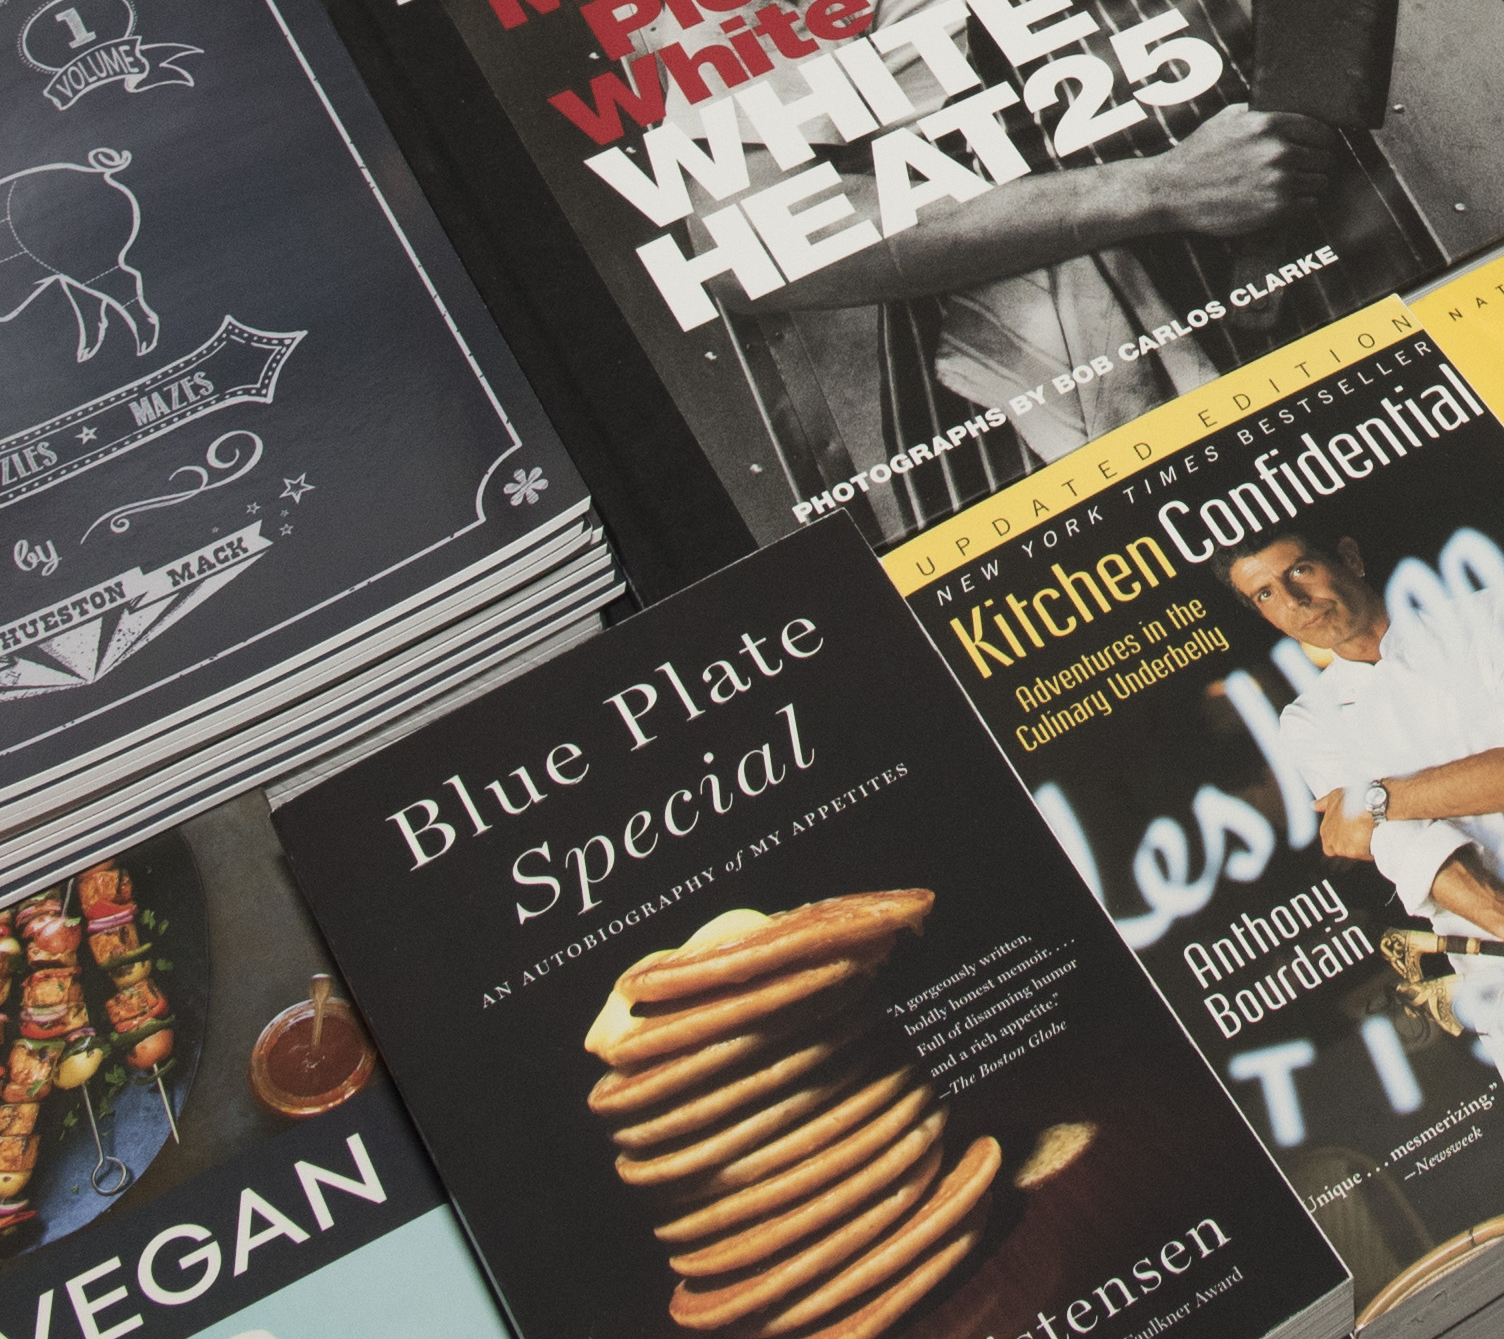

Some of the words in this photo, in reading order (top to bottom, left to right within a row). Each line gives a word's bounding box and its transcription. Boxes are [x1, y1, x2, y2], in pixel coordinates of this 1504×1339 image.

[54, 43, 141, 101] VOLUME
[57, 10, 97, 46] 1
[129, 371, 215, 426] MAZES
[791, 406, 1008, 523] PHOTOGRAPHS
[1009, 384, 1047, 418] BY
[1051, 353, 1114, 399] BOB
[1118, 300, 1225, 366] CARLOS
[1228, 244, 1340, 306] CLARKE
[916, 440, 1155, 577] UPDATED
[1197, 314, 1415, 429] EDITION
[937, 562, 1000, 606] NEW
[1021, 506, 1102, 558] YORK
[1123, 446, 1221, 502] TIMES
[1237, 339, 1432, 444] BESTSELLER
[13, 538, 62, 576] by
[166, 537, 249, 588] MACK
[949, 536, 1178, 679] Kitchen
[1158, 364, 1486, 565] Confidential
[1014, 633, 1136, 714] Adventures
[1138, 622, 1162, 647] in
[1164, 596, 1206, 634] the
[1014, 684, 1111, 752] Culinary
[1107, 624, 1230, 705] Underbelly
[385, 741, 590, 872] Blue
[601, 610, 826, 750] Plate
[509, 703, 818, 925] Special
[480, 981, 514, 1011] AN
[519, 866, 718, 987] AUTOBIOGRAPHY
[722, 848, 746, 875] of
[747, 831, 784, 857] MY
[790, 761, 910, 838] APPETITES
[1184, 878, 1350, 987] Anthony
[906, 963, 977, 1011] gorgeously
[979, 935, 1032, 966] written,
[1203, 922, 1375, 1039] Bourdain
